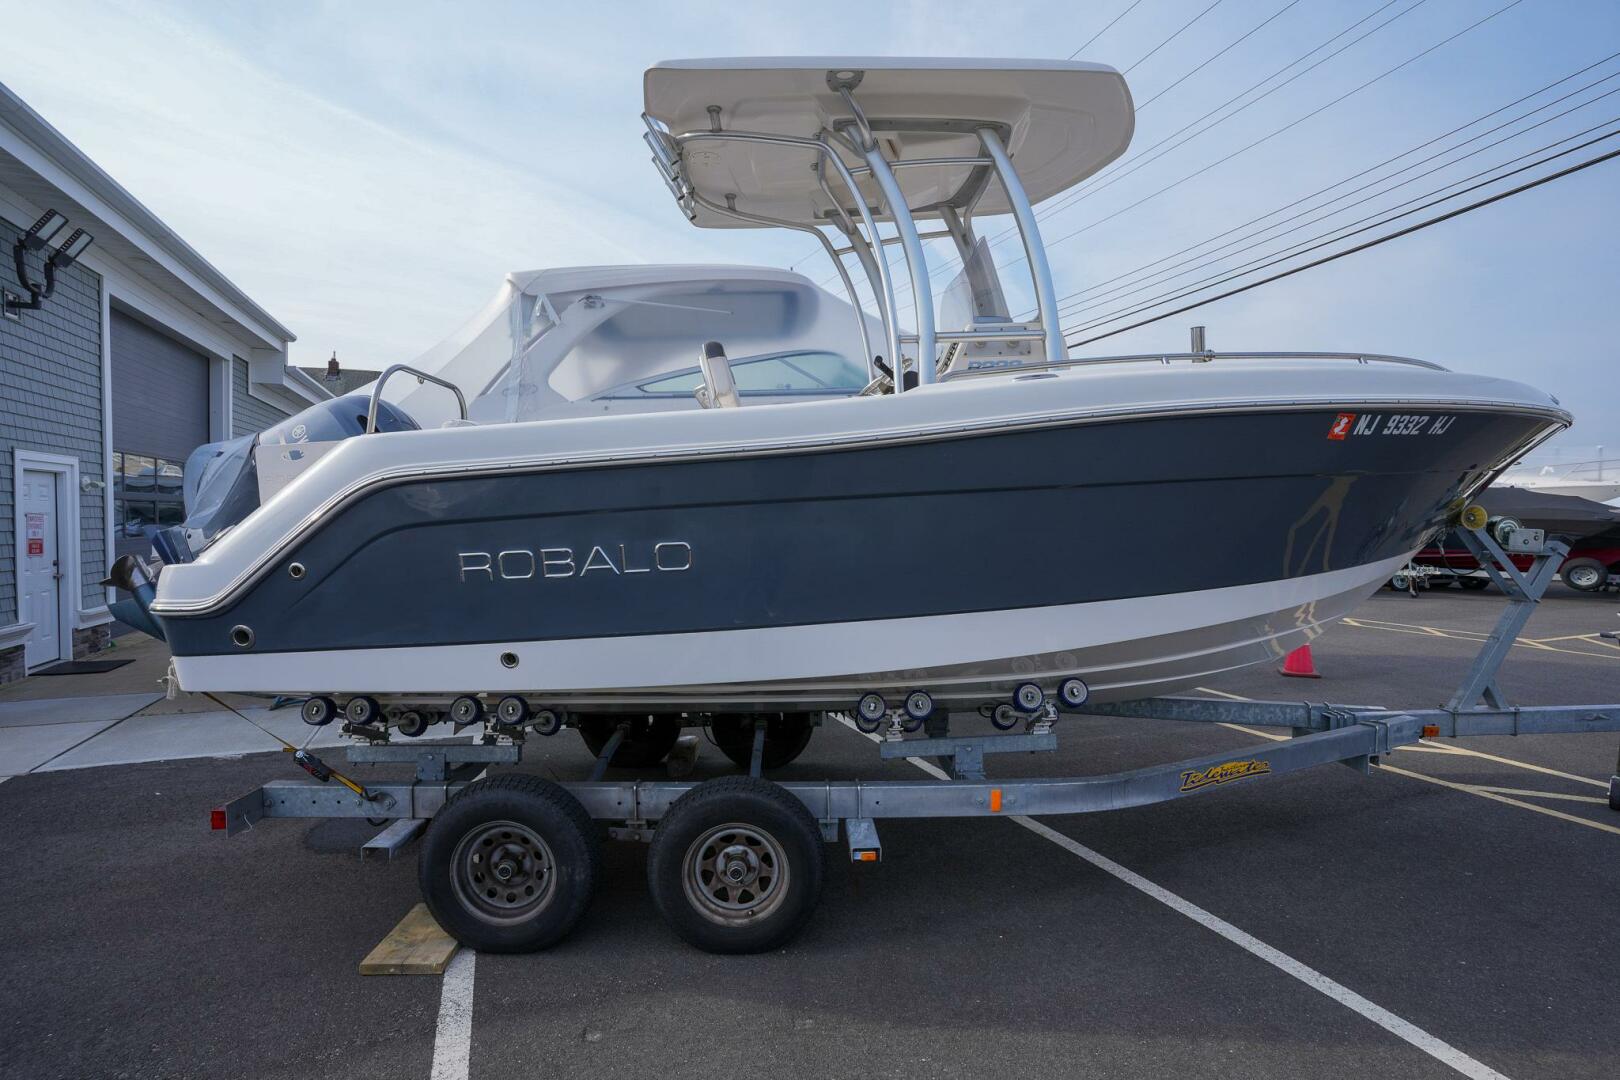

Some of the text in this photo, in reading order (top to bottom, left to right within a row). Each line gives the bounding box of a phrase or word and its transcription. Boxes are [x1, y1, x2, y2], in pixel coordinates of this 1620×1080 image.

[1353, 414, 1382, 435] NJ
[1382, 414, 1430, 435] 9332
[1427, 415, 1457, 435] HJ
[458, 541, 692, 583] ROBALO
